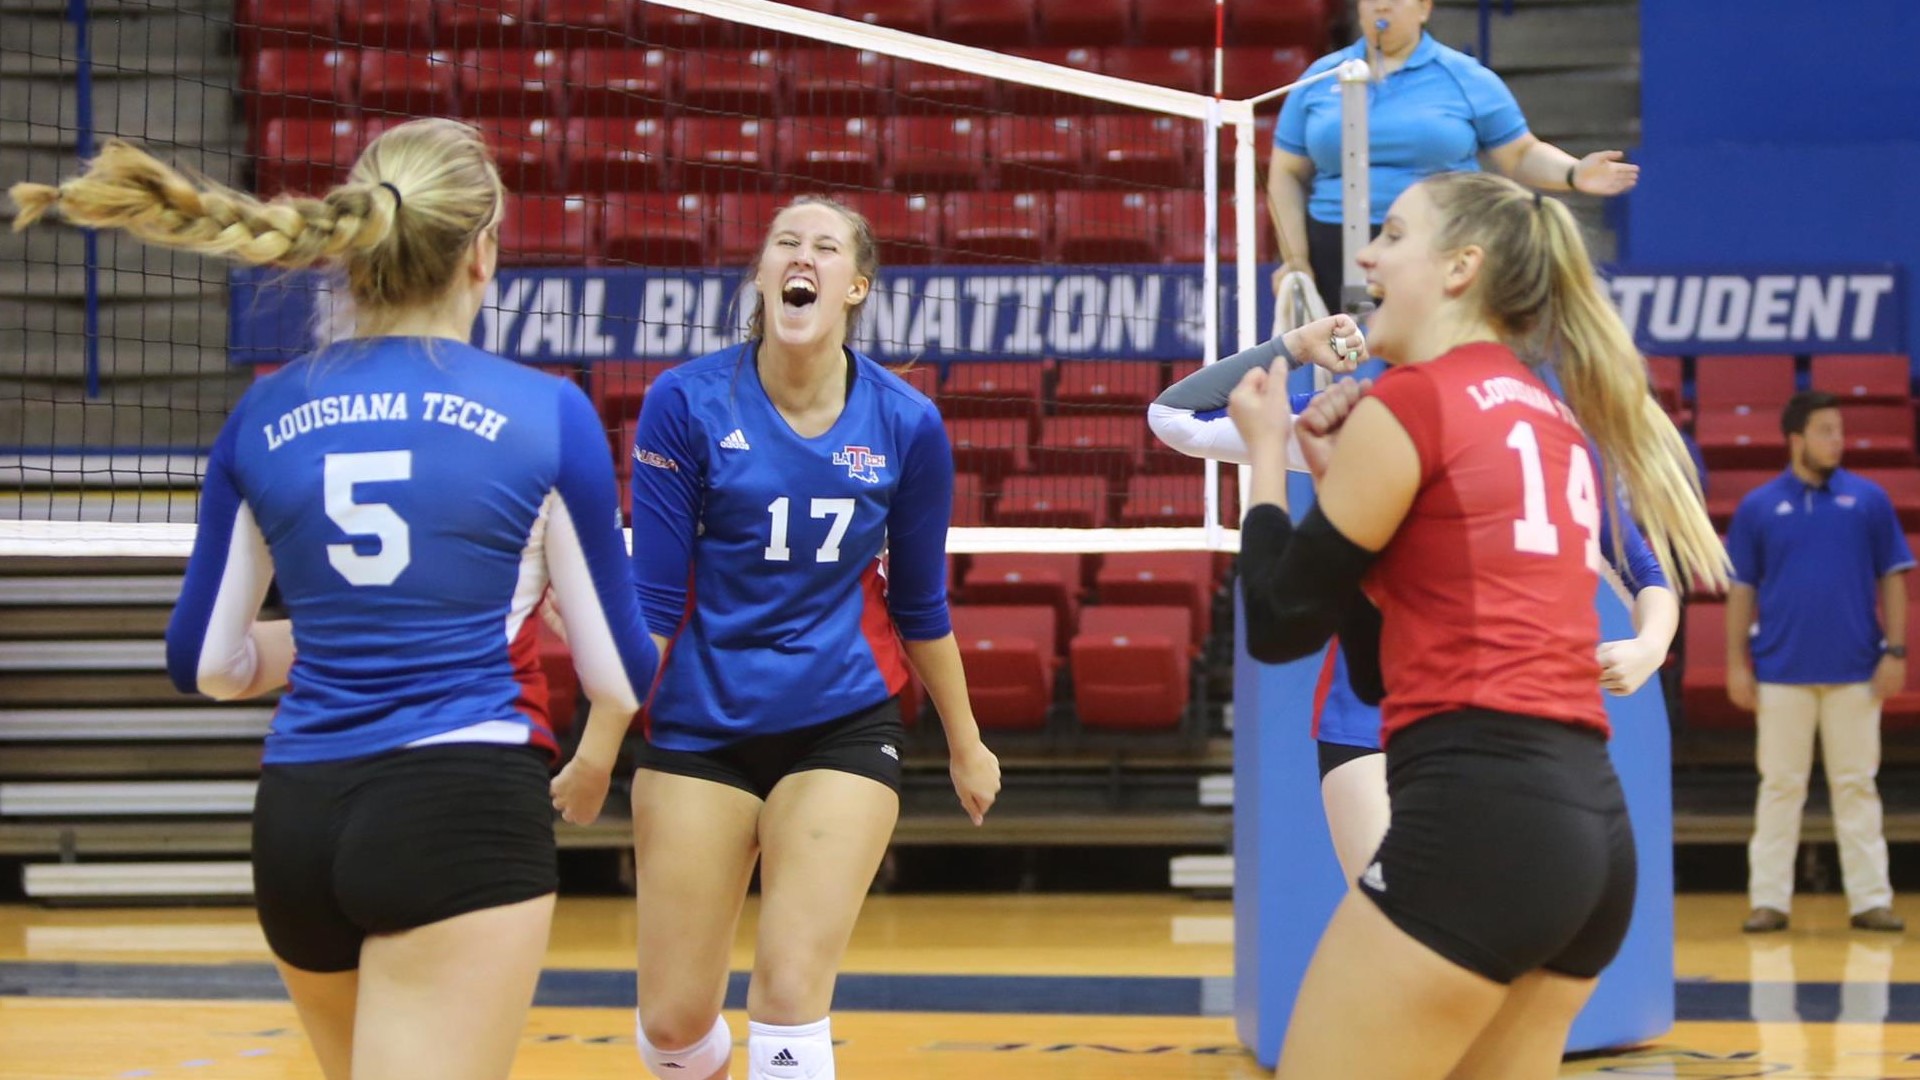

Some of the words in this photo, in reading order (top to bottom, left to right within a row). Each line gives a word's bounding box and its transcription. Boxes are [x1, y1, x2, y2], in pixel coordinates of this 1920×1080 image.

[851, 275, 1160, 355] NATION
[1596, 275, 1893, 341] TUDENT
[263, 392, 408, 451] LOUISIANA
[422, 392, 508, 442] TECH
[323, 450, 412, 586] 5
[764, 496, 856, 563] 17
[1506, 420, 1602, 575] 14
